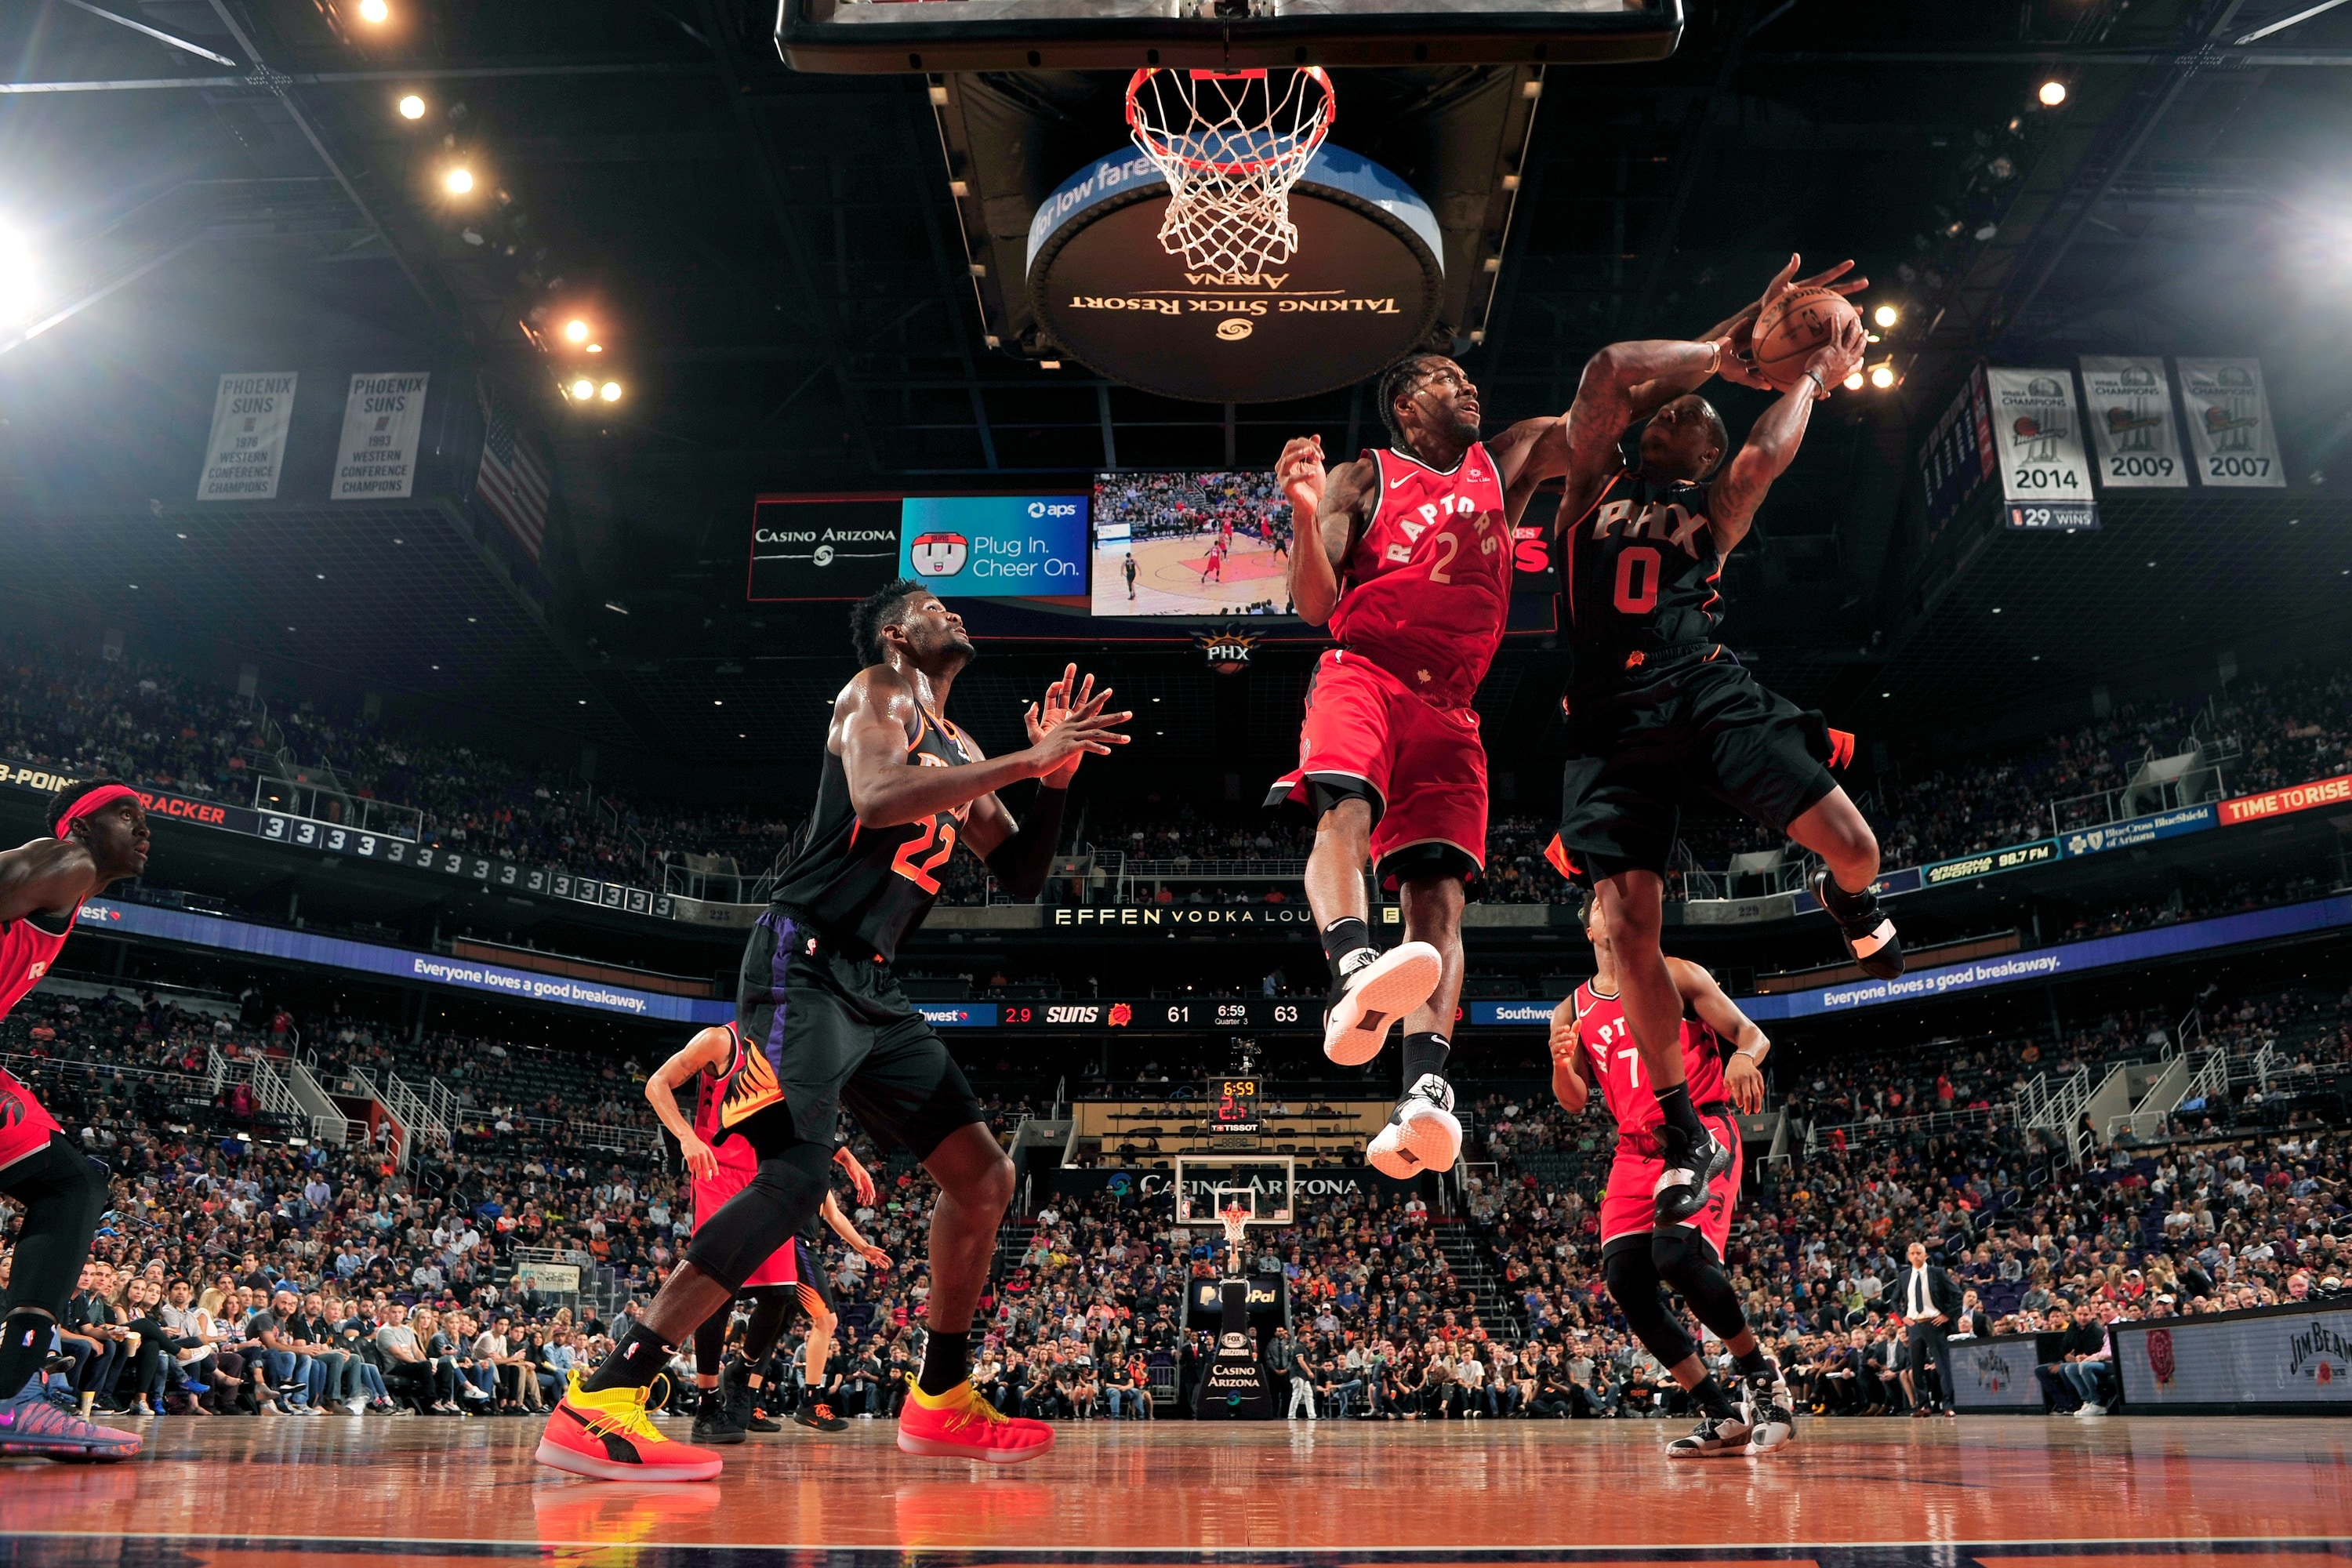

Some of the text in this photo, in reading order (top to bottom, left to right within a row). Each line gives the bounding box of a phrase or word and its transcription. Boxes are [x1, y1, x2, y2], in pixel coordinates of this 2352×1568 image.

[1056, 176, 1094, 217] low
[1184, 272, 1290, 289] ARENA
[1069, 296, 1401, 315] TALKING STICK RESORT
[223, 378, 292, 395] PHOENIX
[354, 378, 424, 394] PHOENIX
[2095, 387, 2159, 396] CHAMPIONS
[231, 397, 274, 413] SUNS
[364, 396, 405, 413] SUNS
[2002, 397, 2067, 407] CHAMPIONS
[236, 437, 258, 448] 1976
[368, 436, 391, 447] 1993
[220, 452, 268, 463] WESTERN
[354, 450, 401, 462] WESTERN
[208, 466, 273, 479] CONFERENCE
[341, 465, 408, 477] CONFERENCE
[2111, 457, 2174, 477] 2009
[2209, 457, 2270, 477] 2007
[209, 481, 268, 493] CHAMPIONS
[342, 480, 402, 493] CHAMPIONS
[2016, 470, 2079, 488] 2014
[1047, 503, 1076, 517] aps
[2025, 508, 2051, 526] 29
[2055, 514, 2091, 525] WINS
[755, 528, 896, 543] CASINO ARIZONA
[1385, 492, 1498, 564] RAPTORS
[1592, 499, 1708, 560] PHX
[974, 536, 1049, 557] Plug In.
[1428, 532, 1458, 584] 2
[973, 558, 1080, 577] Cheer On.
[1613, 546, 1661, 614] 0
[1207, 644, 1250, 661] PHX
[0, 764, 226, 824] 3-POIN RACKER
[2229, 779, 2351, 819] TIME TO RISE
[2105, 808, 2208, 838] BlueCross BlueShield
[2119, 831, 2155, 846] Arizona
[891, 813, 956, 895] 22
[1999, 846, 2049, 867] 98.7 FM
[266, 818, 670, 915] 3 3 3 3 3 3 3 3 3 3 3 3 3 3 3
[1929, 857, 1992, 877] ARIZONA
[1931, 865, 1991, 883] SPORTS
[1055, 909, 1161, 925] EFFEN
[1171, 910, 1254, 922] VODKA
[1265, 910, 1311, 922] LOU
[414, 958, 647, 1013] Everyone loves a good breakaway.
[1824, 956, 2061, 1007] Everyone loves a good breakaway.
[918, 1008, 958, 1022] hwest
[1006, 1006, 1298, 1023] 2.9 SUNS 61 63
[1218, 1005, 1246, 1017] 6:59
[1496, 1007, 1553, 1020] Southwe
[1617, 1047, 1639, 1089] 7
[1224, 1081, 1254, 1096] 6:59
[2290, 1331, 2313, 1375] JIM
[1212, 1365, 1256, 1376] CASINO
[1208, 1377, 1260, 1387] ARIZONA
